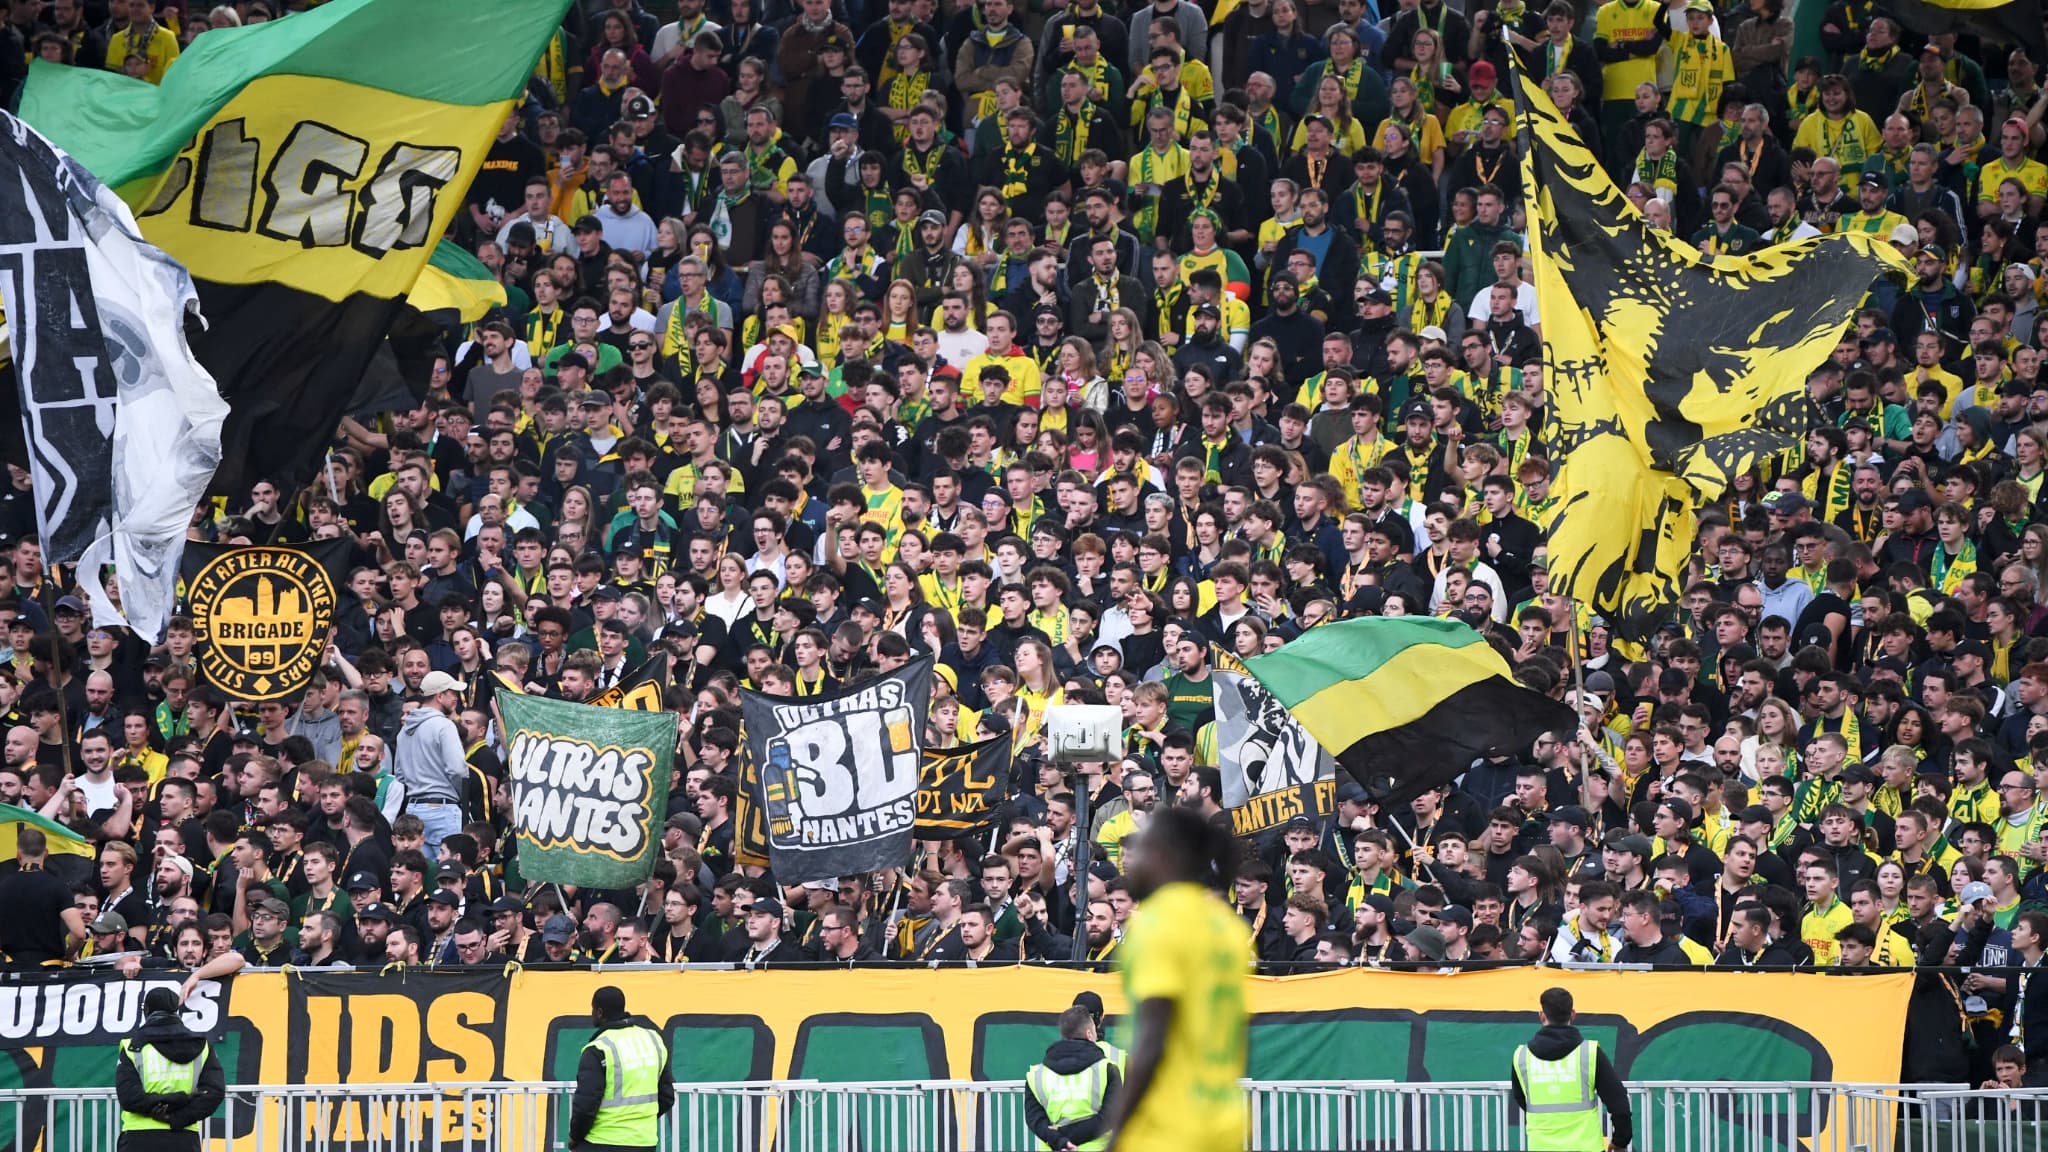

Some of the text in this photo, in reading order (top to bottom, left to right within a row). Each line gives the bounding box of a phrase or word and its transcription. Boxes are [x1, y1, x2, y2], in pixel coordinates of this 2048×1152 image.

[192, 552, 331, 689] STILL CRAZY AFTER ALL THESE YEARS
[219, 622, 304, 639] BRIGADE
[250, 651, 275, 665] 99
[511, 734, 647, 801] ULTRAS
[801, 800, 915, 844] NANTES
[305, 991, 496, 1096] IDS
[305, 1099, 494, 1142] NANTES
